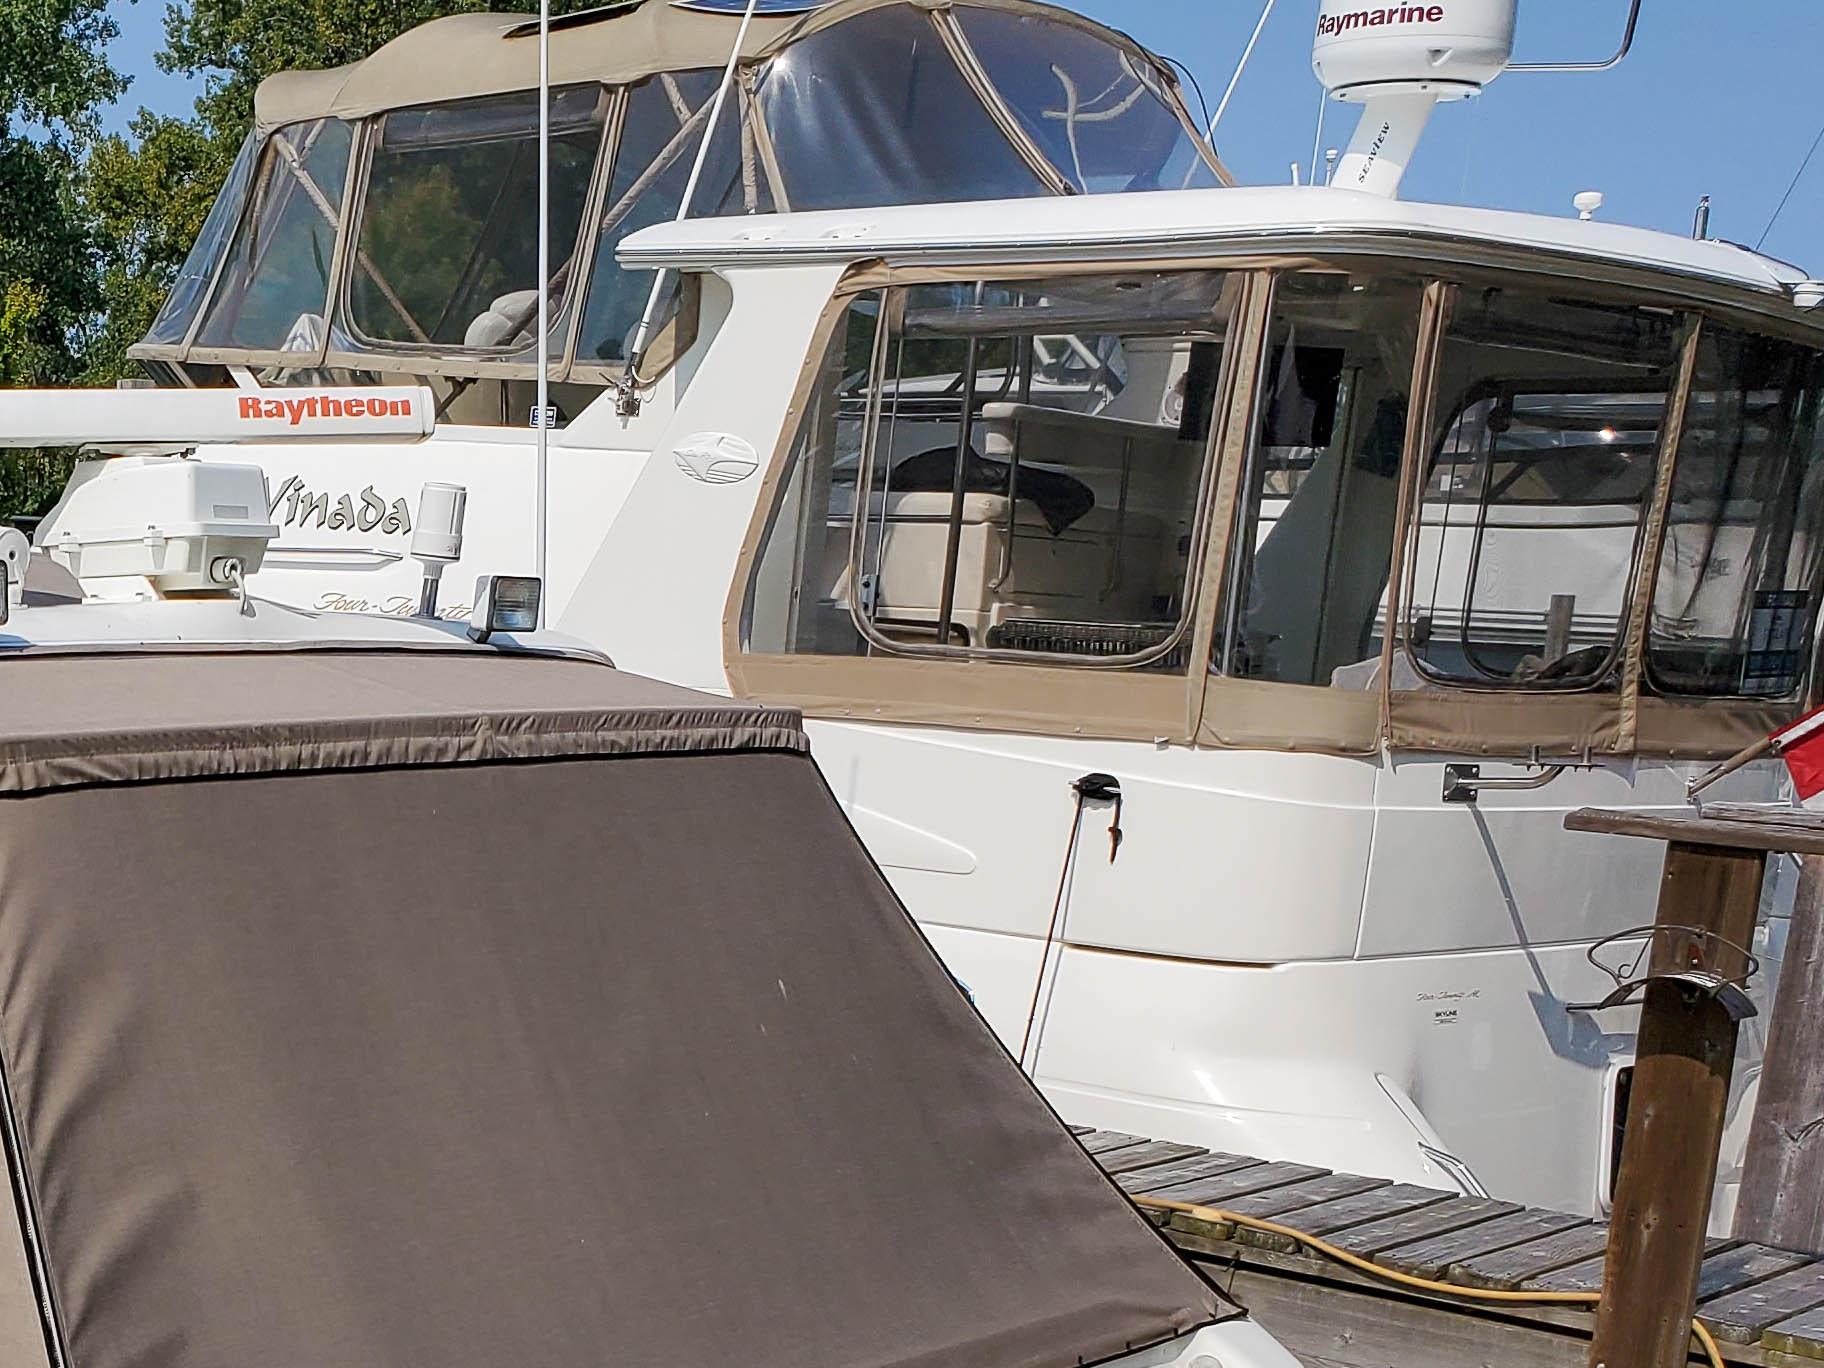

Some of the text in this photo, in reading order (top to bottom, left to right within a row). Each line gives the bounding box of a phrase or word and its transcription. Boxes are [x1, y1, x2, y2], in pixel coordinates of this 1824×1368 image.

[1316, 1, 1444, 37] Raymarine
[1358, 122, 1391, 183] SEAVIEW
[238, 396, 412, 425] Raytheon
